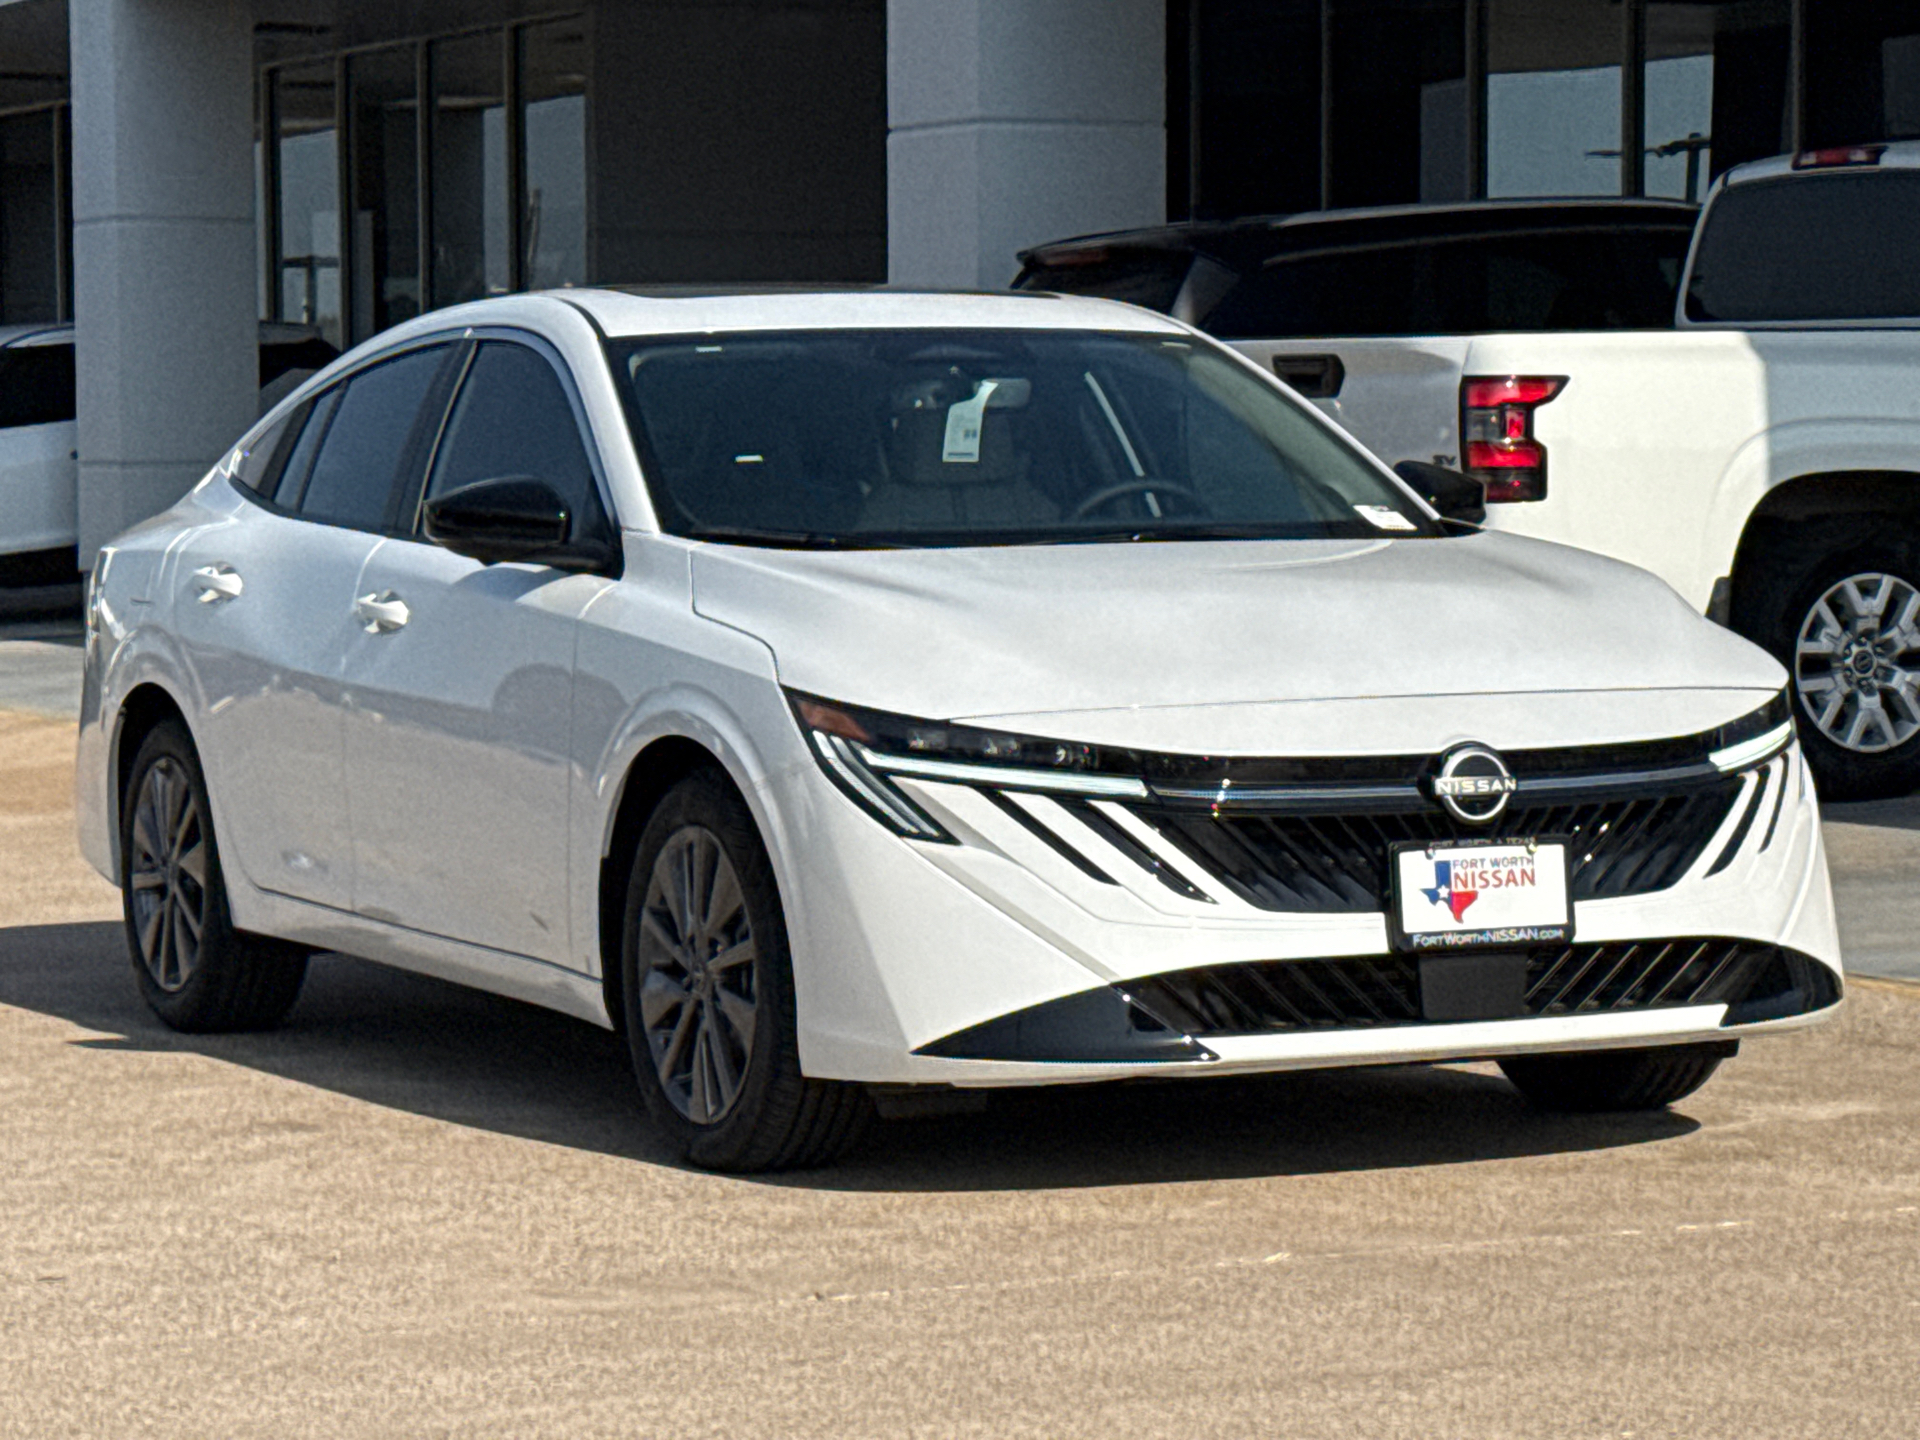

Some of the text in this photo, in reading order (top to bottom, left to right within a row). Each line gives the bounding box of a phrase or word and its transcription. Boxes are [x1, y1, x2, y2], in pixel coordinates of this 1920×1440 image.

[1436, 778, 1517, 796] NISSAN
[1452, 855, 1535, 870] FORT WORTH
[1453, 868, 1537, 890] NISSAN
